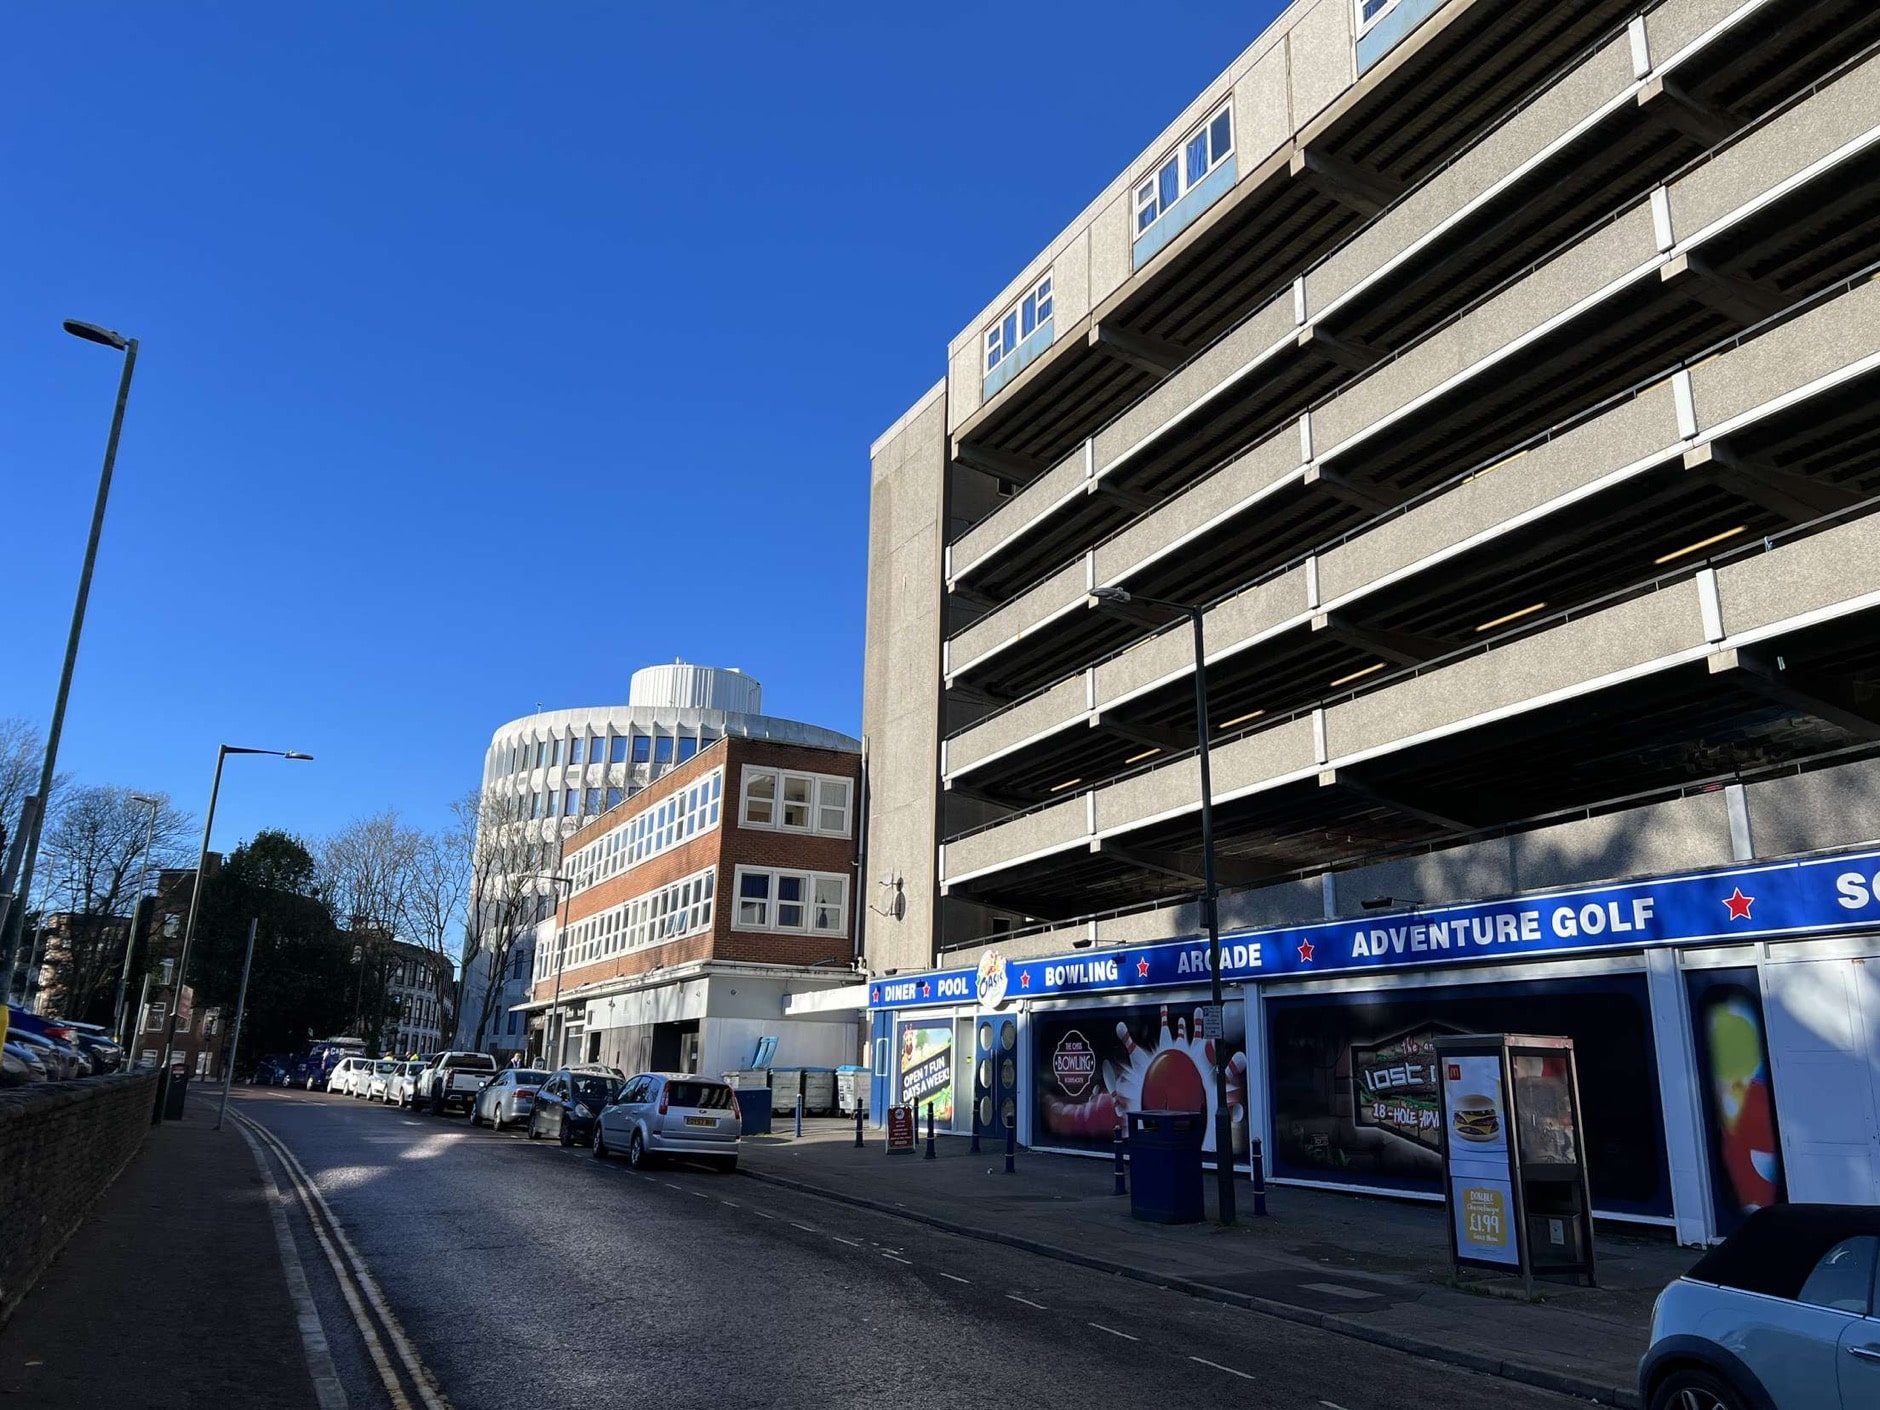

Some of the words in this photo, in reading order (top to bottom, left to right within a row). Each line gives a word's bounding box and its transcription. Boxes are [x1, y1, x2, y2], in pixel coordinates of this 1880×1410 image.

[1836, 871, 1880, 909] S
[1352, 911, 1542, 958] ADVENTURE
[1552, 897, 1655, 938] GOLF
[1045, 959, 1118, 986] BOWLING
[884, 983, 917, 1002] DINER
[937, 977, 969, 997] POOL
[1401, 1037, 1418, 1054] the
[904, 1067, 923, 1087] OPEN
[924, 1064, 930, 1076] 7
[929, 1056, 946, 1073] FUN
[1057, 1055, 1091, 1071] BOWLING
[903, 1082, 920, 1102] DAYS
[920, 1082, 927, 1095] A
[926, 1067, 950, 1091] WEEK!
[1469, 1213, 1500, 1233] £1.99
